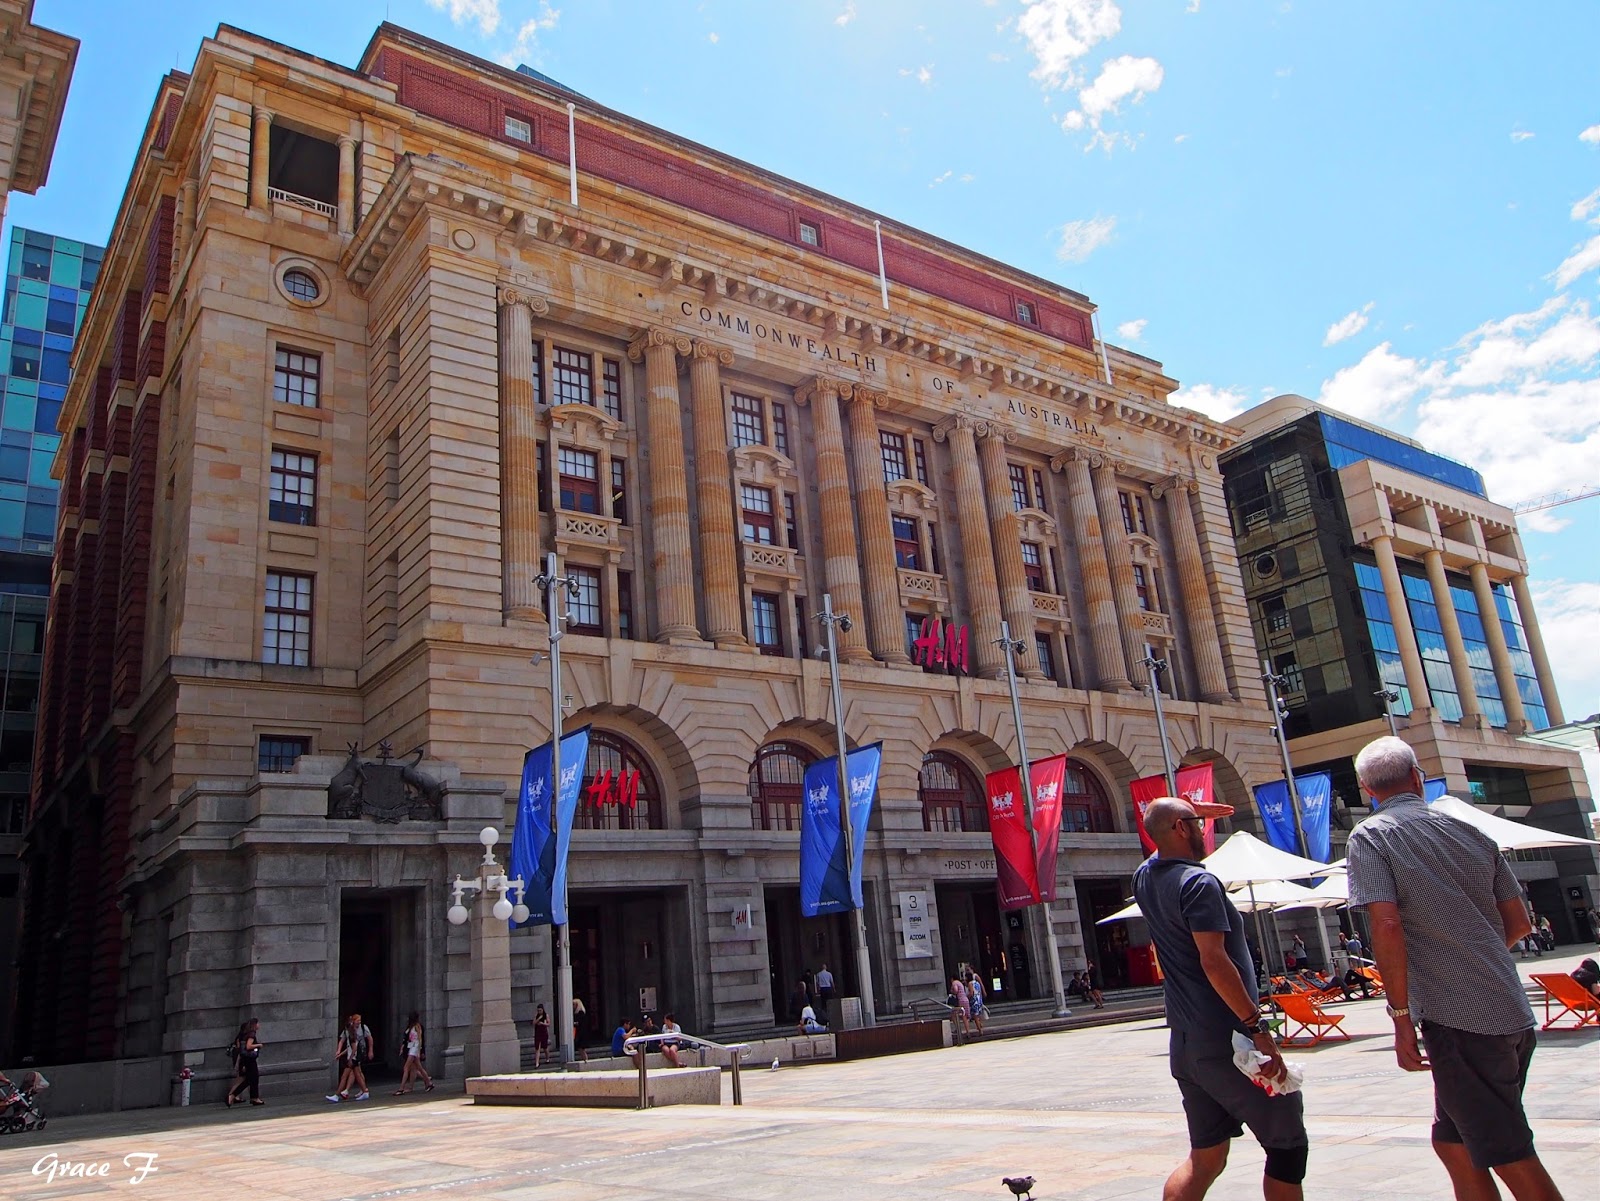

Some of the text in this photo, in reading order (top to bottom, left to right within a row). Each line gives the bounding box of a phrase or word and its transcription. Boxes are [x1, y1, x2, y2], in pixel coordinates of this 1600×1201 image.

[681, 301, 1099, 437] COMMONWEALTH OF AUSTRALIA
[913, 616, 969, 674] H&M
[585, 768, 640, 809] H&M
[909, 895, 918, 909] 3
